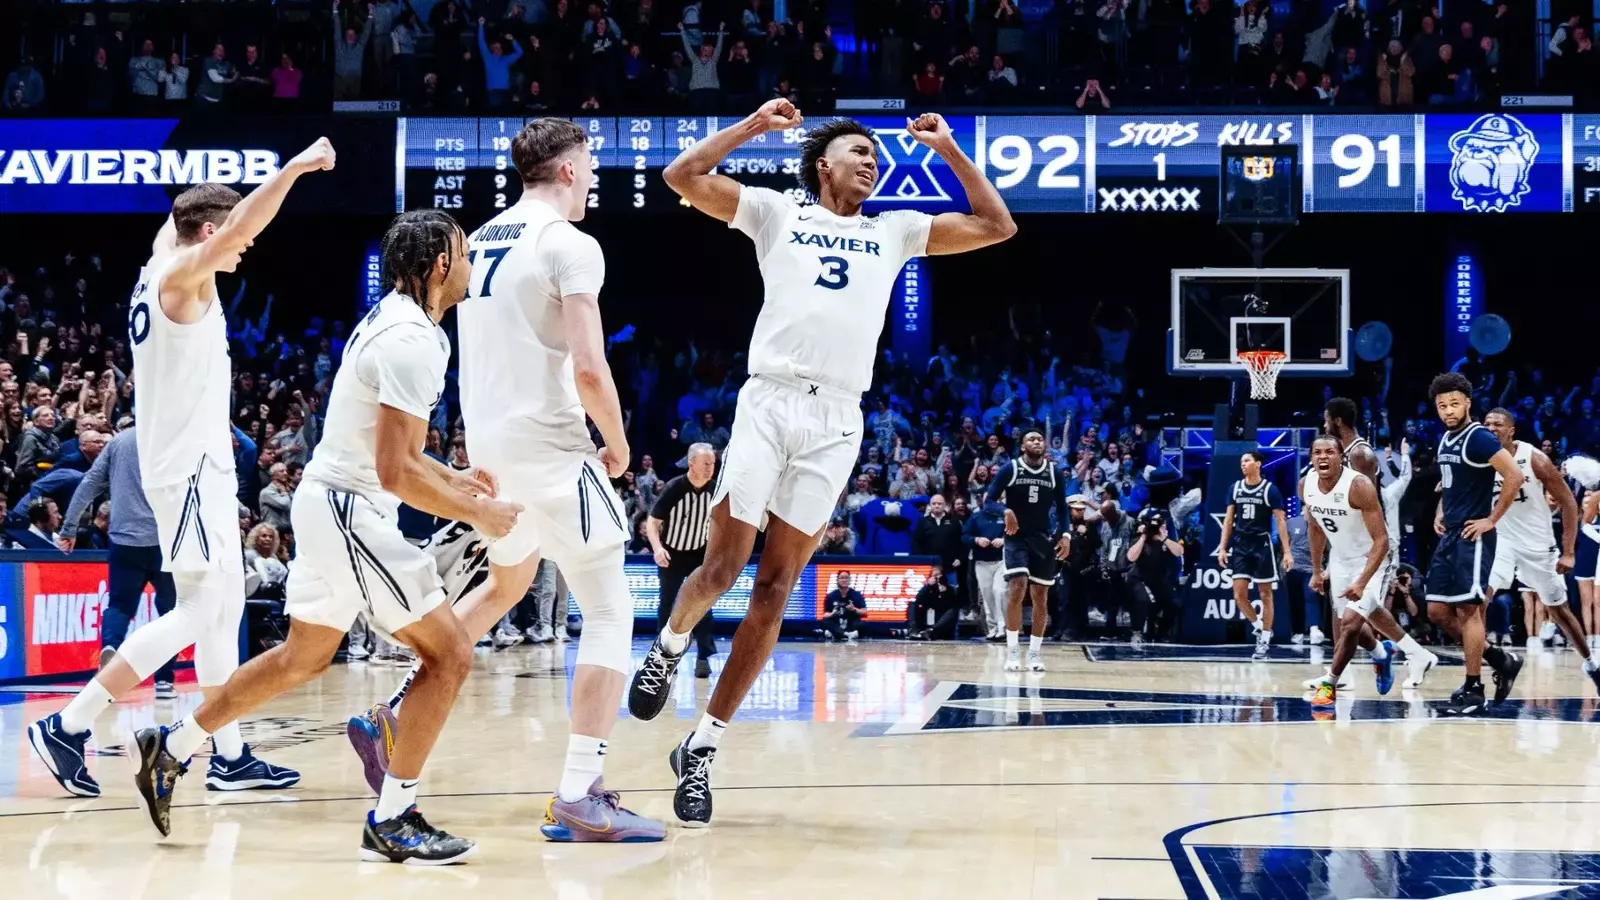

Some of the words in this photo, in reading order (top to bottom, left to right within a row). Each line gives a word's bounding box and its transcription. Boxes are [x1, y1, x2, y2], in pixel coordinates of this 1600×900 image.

[883, 100, 902, 108] 221
[1504, 96, 1524, 105] 221
[498, 120, 505, 133] 1
[589, 119, 600, 133] 8
[630, 119, 652, 133] 20
[677, 119, 698, 133] 24
[1109, 121, 1199, 147] STOPS
[1217, 120, 1293, 147] KILLS
[435, 138, 465, 151] PTS
[492, 136, 510, 151] 19
[630, 136, 650, 151] 18
[677, 136, 696, 151] 10
[435, 156, 466, 171] REB
[495, 155, 508, 170] 5
[634, 155, 646, 170] 2
[725, 158, 778, 174] 3FG%
[989, 135, 1080, 189] 92
[1152, 152, 1166, 181] 1
[1331, 134, 1401, 188] 91
[434, 175, 466, 190] AST
[494, 174, 507, 189] 9
[634, 174, 646, 189] 5
[434, 194, 463, 208] FLS
[494, 193, 507, 208] 2
[587, 193, 600, 208] 2
[633, 193, 645, 208] 3
[1098, 187, 1201, 212] XXXXX
[474, 222, 527, 242] DJOKOVIC
[789, 230, 881, 257] XAVIER
[814, 255, 849, 290] 3
[128, 302, 151, 346] 0
[1028, 485, 1039, 503] 5
[1242, 503, 1256, 519] 31
[1322, 517, 1338, 533] 8
[1191, 568, 1278, 590] JOS
[866, 597, 916, 612] WAS
[1203, 598, 1264, 620] AUO
